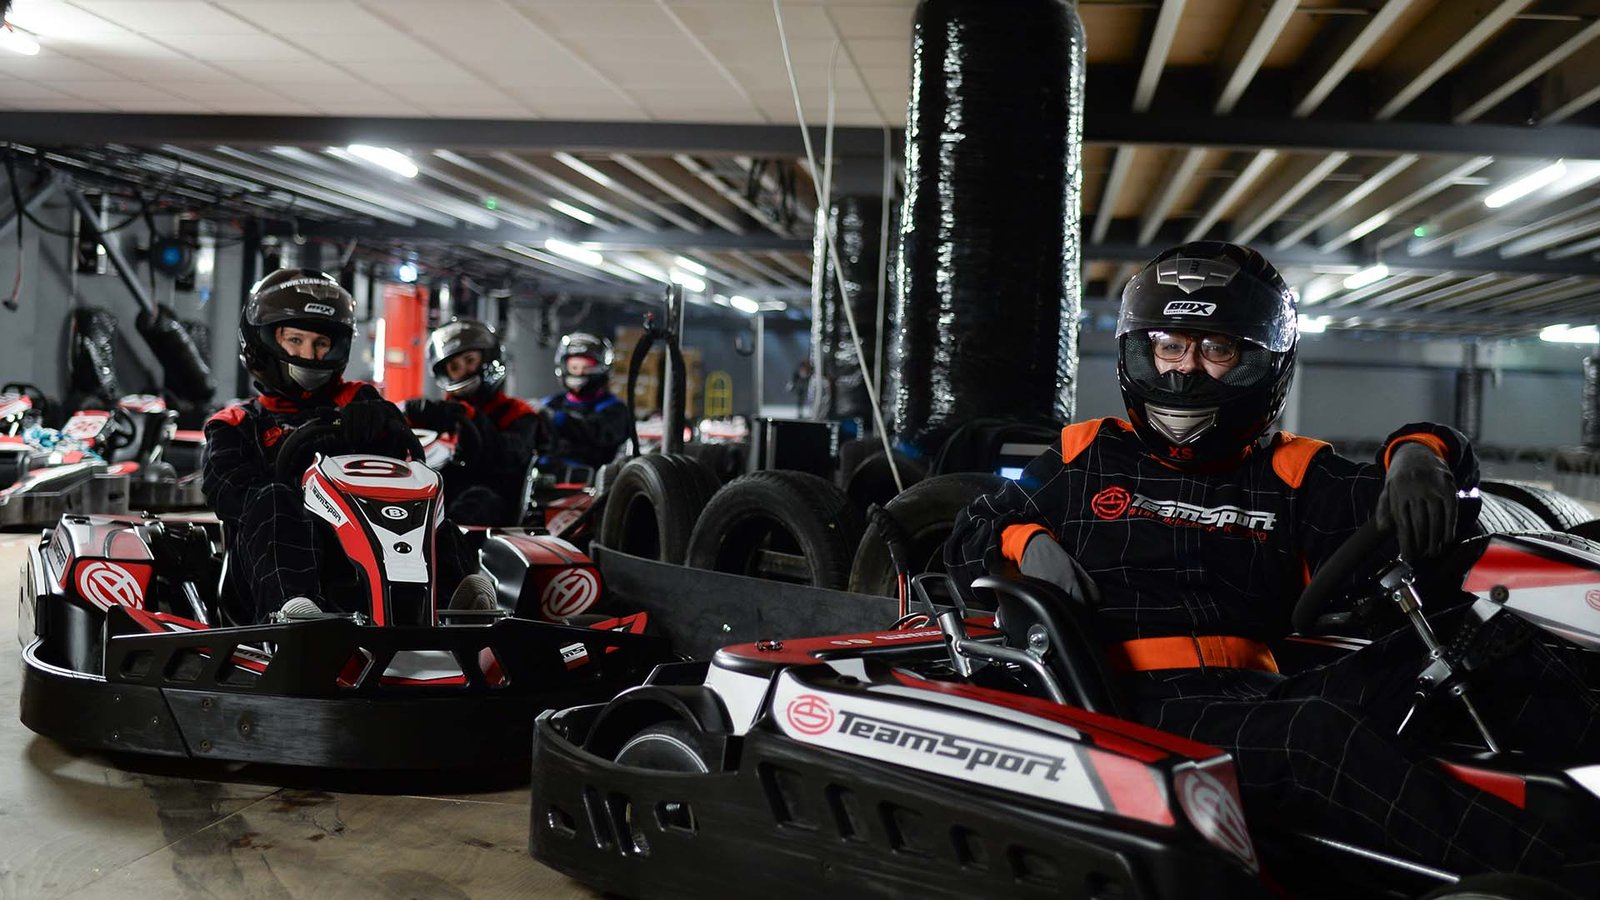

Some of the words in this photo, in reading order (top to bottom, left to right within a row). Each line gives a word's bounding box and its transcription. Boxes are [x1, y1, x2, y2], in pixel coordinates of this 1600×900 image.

[1167, 302, 1213, 315] BOX
[1131, 493, 1277, 530] TeamSport
[838, 710, 1066, 782] TeamSport
